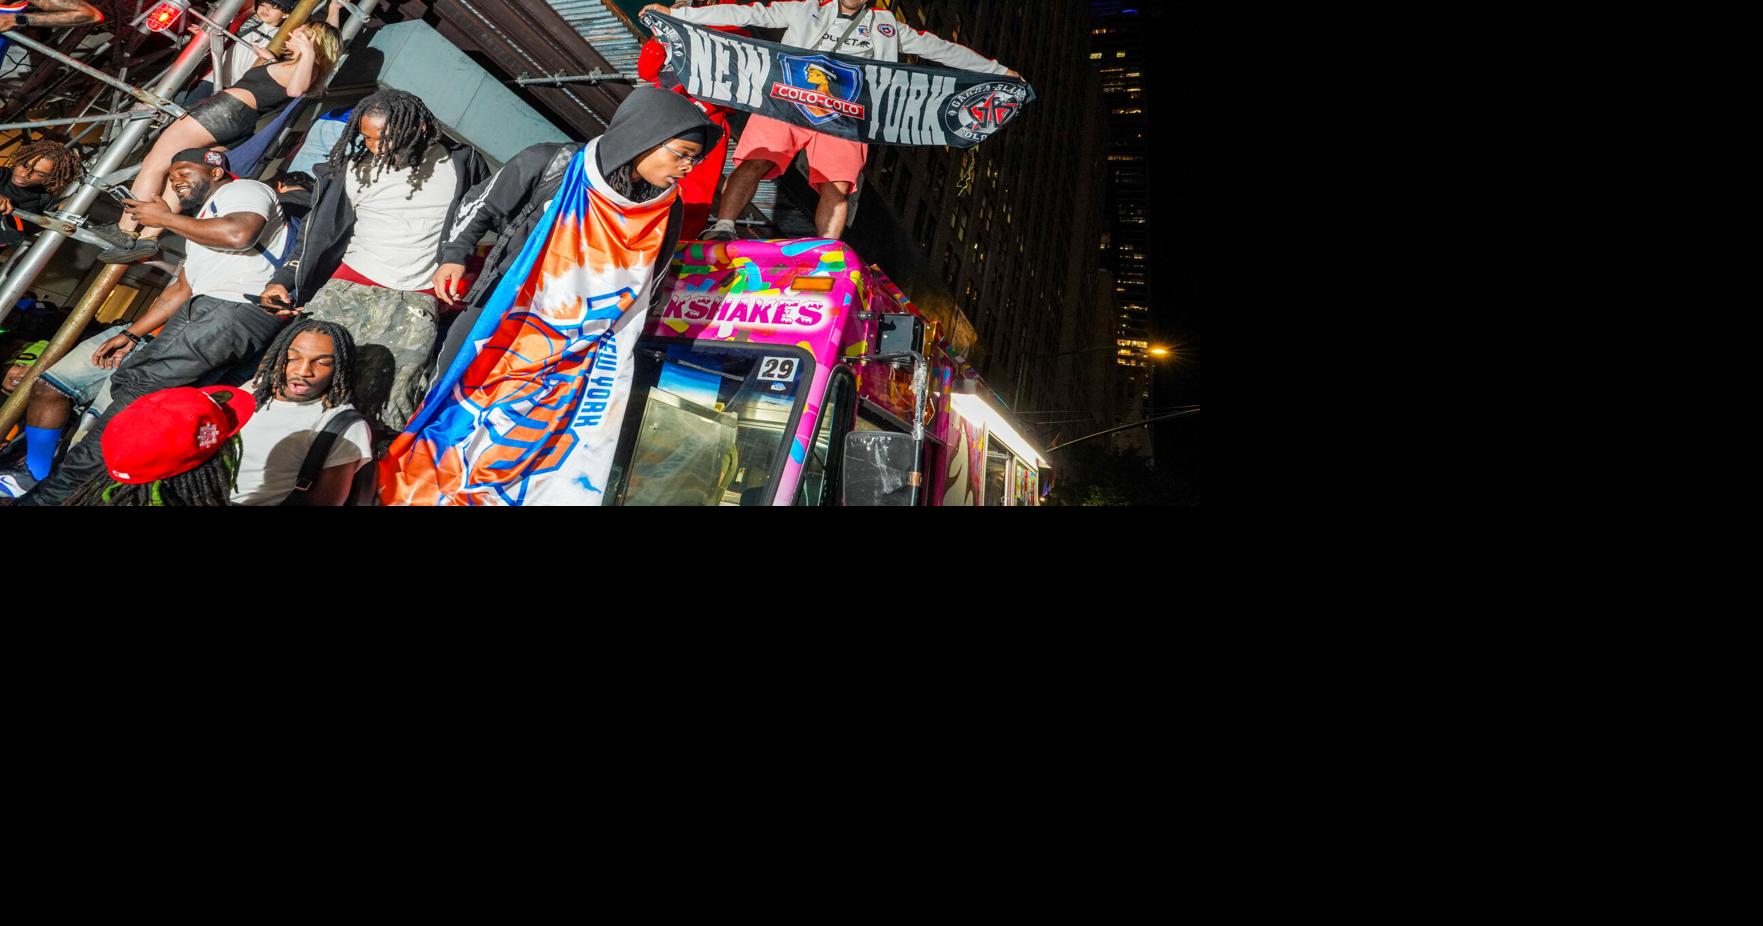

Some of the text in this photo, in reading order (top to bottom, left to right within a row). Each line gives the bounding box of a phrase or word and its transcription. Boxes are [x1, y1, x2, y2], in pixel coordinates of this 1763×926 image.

[683, 24, 956, 145] NEW YORK
[778, 86, 859, 115] COLO-COLO
[655, 294, 824, 326] KSHAKES
[762, 359, 795, 380] 29
[573, 375, 614, 428] YORK
